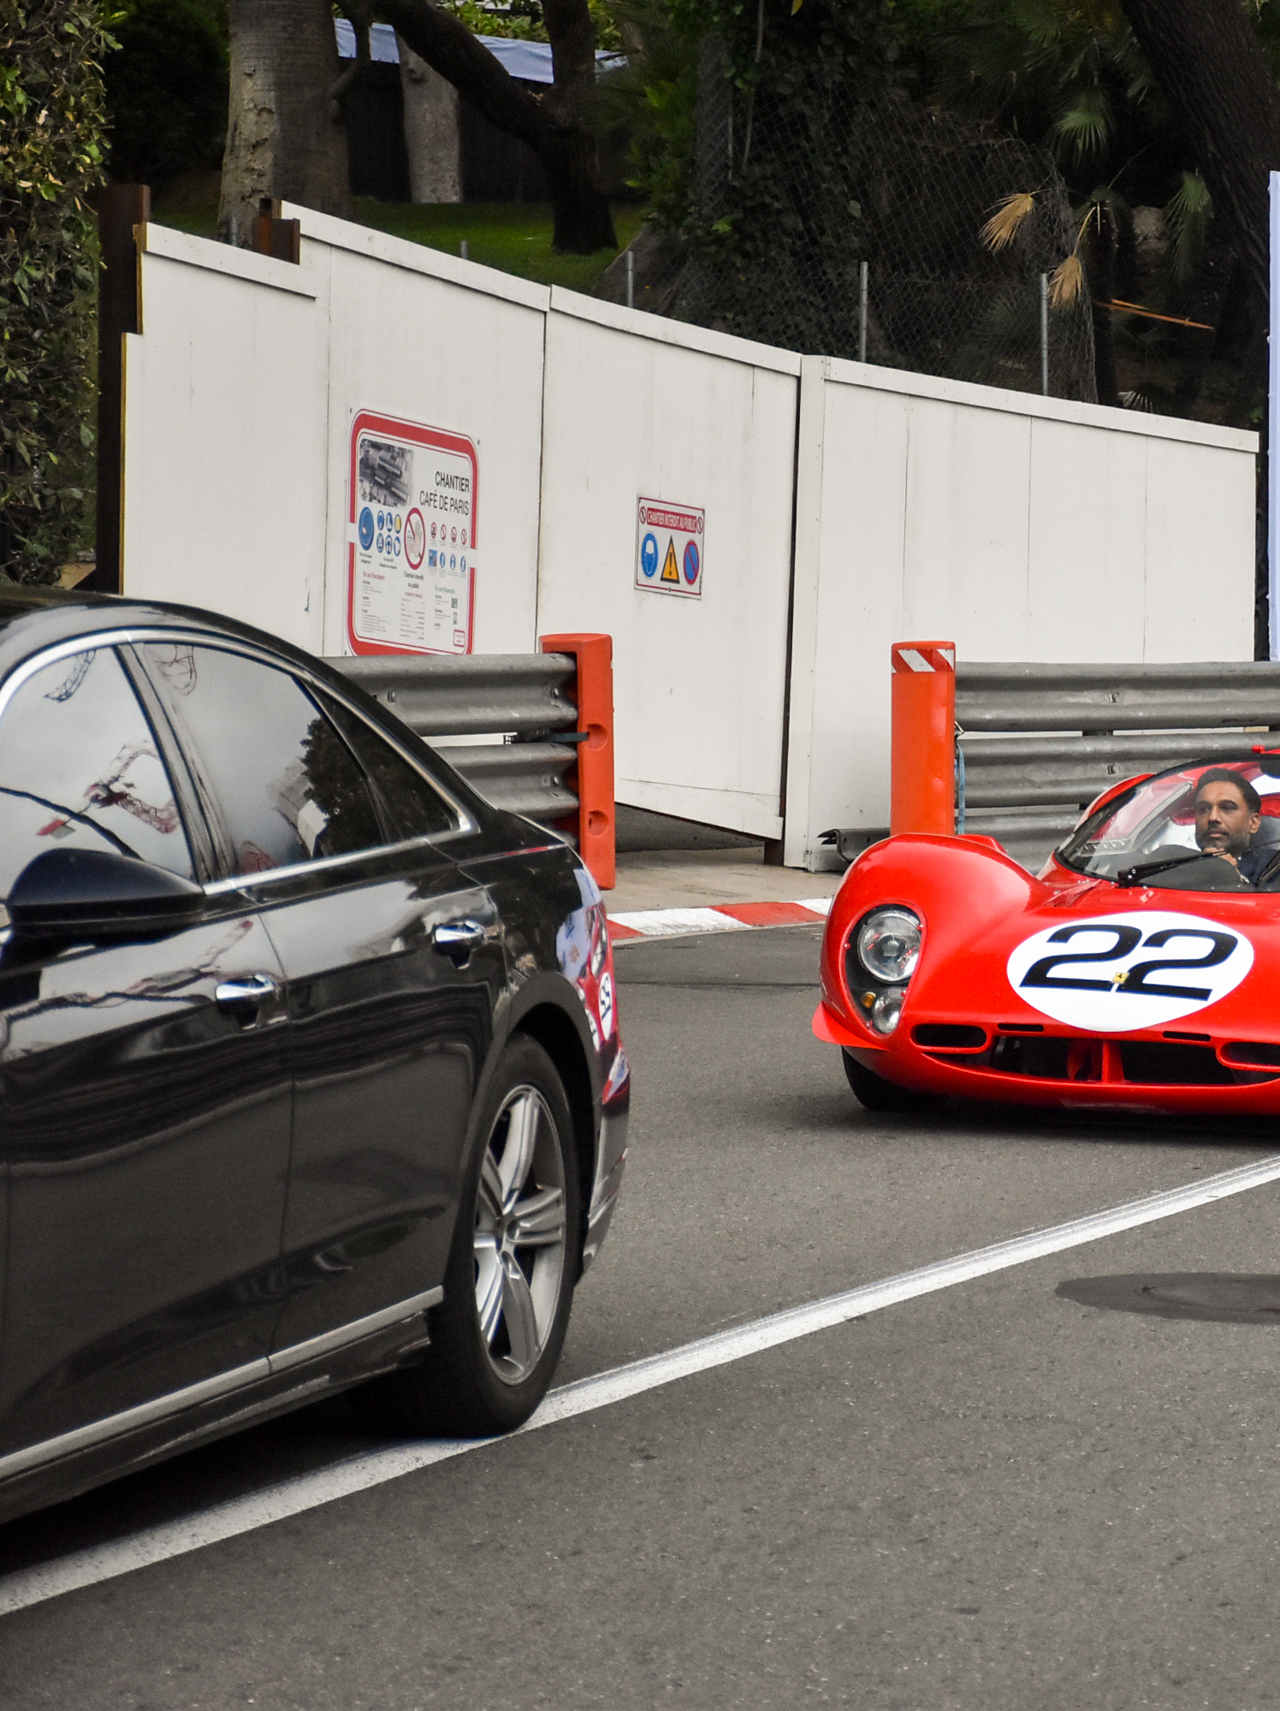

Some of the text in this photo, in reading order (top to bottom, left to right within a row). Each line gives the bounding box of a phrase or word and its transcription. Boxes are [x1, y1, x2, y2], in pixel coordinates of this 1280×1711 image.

[435, 471, 470, 493] CHANTIER
[420, 489, 469, 516] CAFÉ DE PARIS
[1019, 924, 1239, 1002] 22
